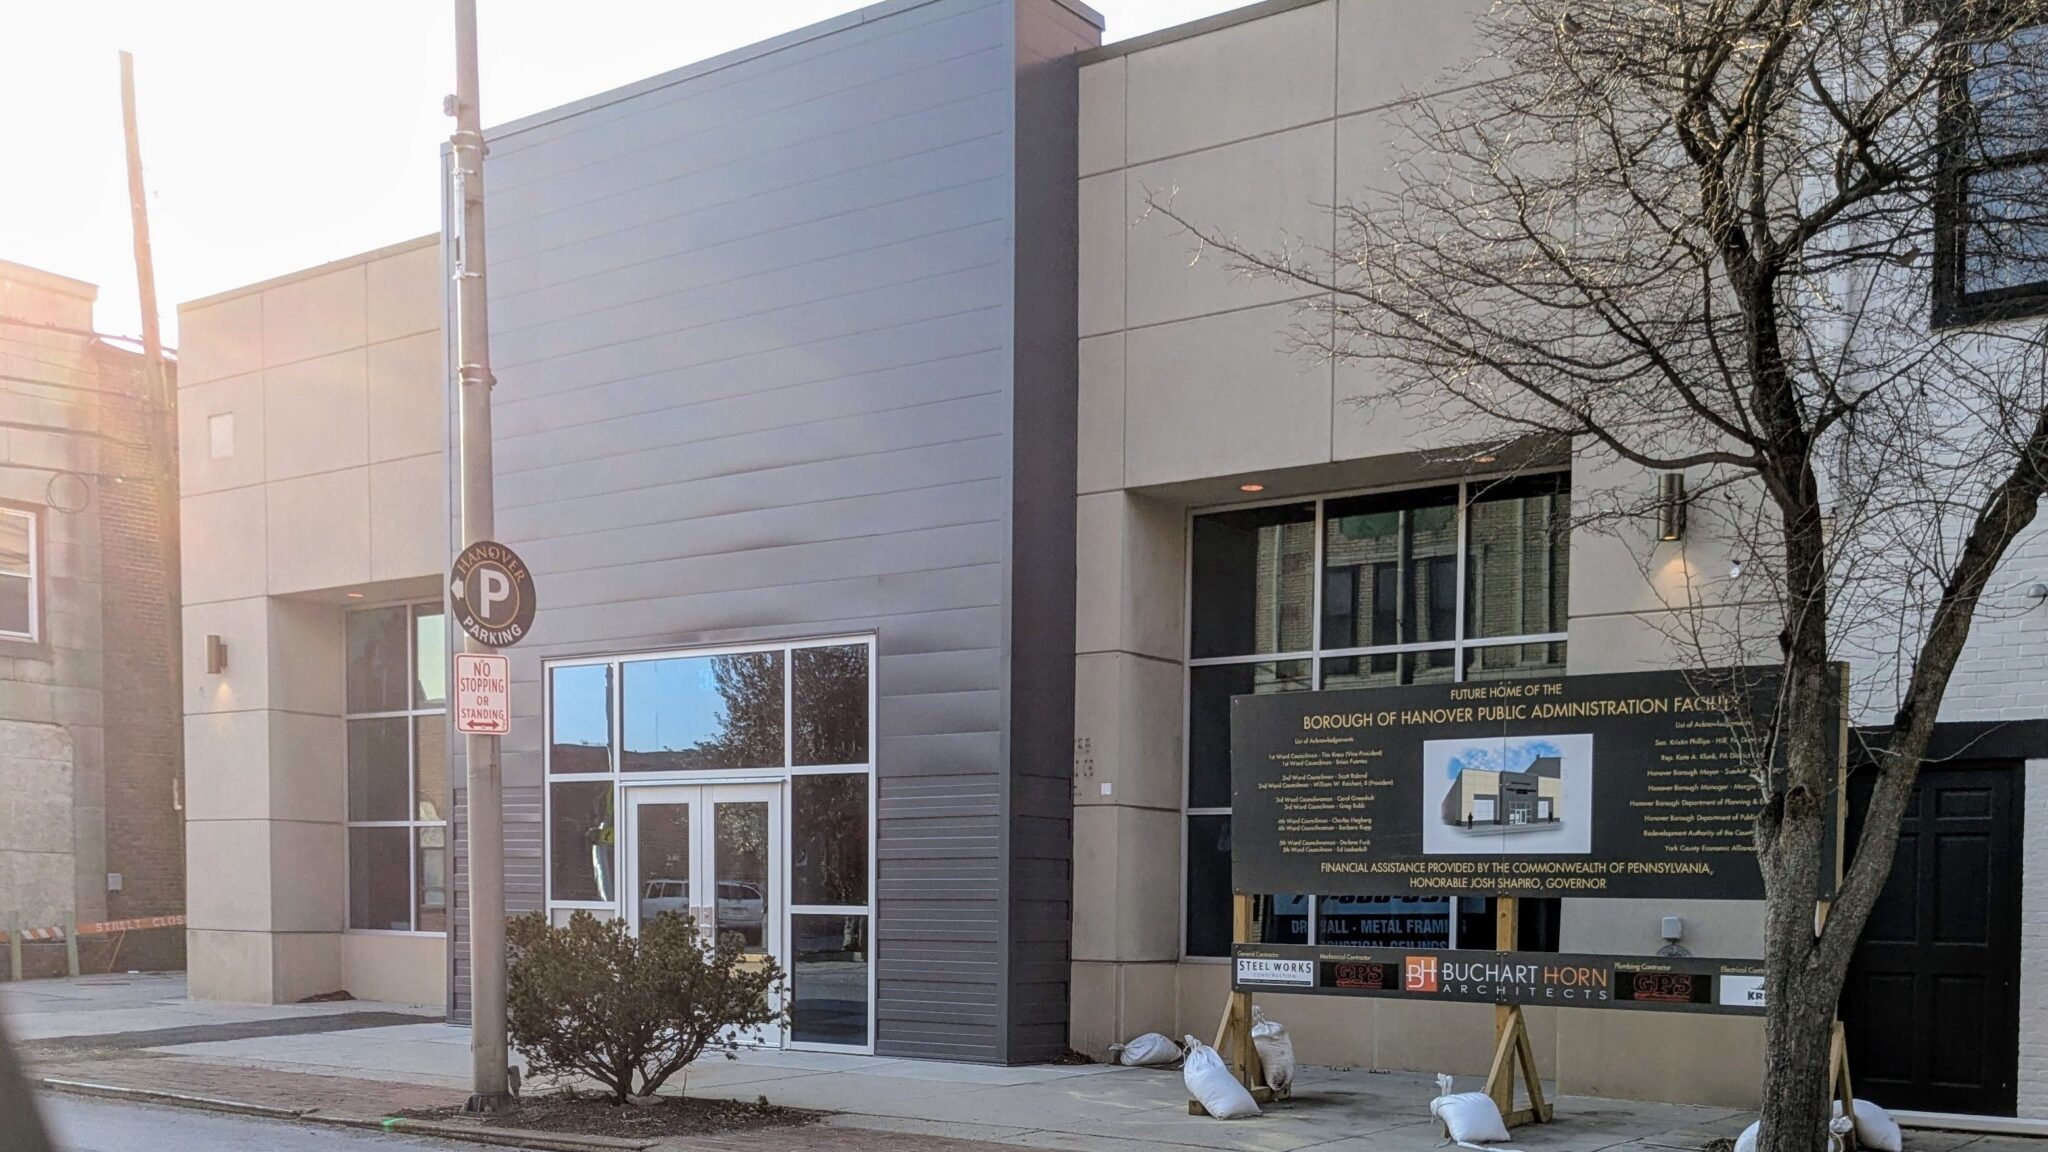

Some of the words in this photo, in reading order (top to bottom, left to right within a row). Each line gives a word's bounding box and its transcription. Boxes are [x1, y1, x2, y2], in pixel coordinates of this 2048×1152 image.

[457, 546, 525, 584] HANOVER
[480, 568, 510, 619] P
[463, 615, 522, 645] PARKING
[473, 662, 491, 677] NO
[460, 677, 504, 693] STOPPING
[1450, 687, 1487, 700] FUTURE
[1489, 685, 1521, 698] HOME
[1524, 685, 1540, 696] OF
[1542, 684, 1562, 695] THE
[476, 695, 489, 706] OR
[461, 709, 504, 720] STANDING
[1303, 713, 1373, 730] BOROUGH
[1377, 711, 1397, 727] OF
[1401, 708, 1473, 725] HANOVER
[1478, 704, 1526, 721] PUBLIC
[1531, 698, 1668, 719] ADMINISTRATION
[1647, 769, 1672, 777] Hanover
[1673, 769, 1698, 777] Borough
[1700, 769, 1719, 777] Mayor
[1674, 784, 1698, 792] Borough
[1701, 784, 1728, 792] Manager
[1655, 800, 1680, 808] Borough
[1681, 800, 1716, 808] Department
[1697, 814, 1730, 822] Department
[1732, 813, 1739, 821] of
[1644, 830, 1687, 838] Redevelopment
[1688, 829, 1714, 837] Authority
[1679, 844, 1700, 852] County
[1321, 862, 1369, 873] FINANCIAL
[1370, 862, 1426, 873] ASSISTANCE
[1428, 862, 1475, 873] PROVIDED
[1477, 862, 1490, 873] BY
[1492, 862, 1509, 873] THE
[1512, 862, 1606, 874] COMMONWEALTH
[1609, 862, 1625, 873] OF
[1627, 863, 1714, 875] PENNSYLVANIA,
[1410, 877, 1468, 888] HONORABLE
[1469, 877, 1495, 888] JOSH
[1497, 878, 1543, 890] SHAPIRO,
[1546, 878, 1607, 889] GOVERNOR
[152, 915, 187, 928] CLOS
[1361, 919, 1403, 934] METAL
[1406, 919, 1467, 934] FRAMI
[1320, 952, 1346, 960] Mechanical
[1239, 960, 1270, 971] STEEL
[1273, 962, 1312, 973] WORKS
[1614, 962, 1640, 972] Plumbing
[1641, 963, 1672, 971] Contractor
[1442, 962, 1538, 984] BUCHART
[1543, 966, 1607, 987] HORN
[1442, 984, 1608, 1000] ARCHITECTS
